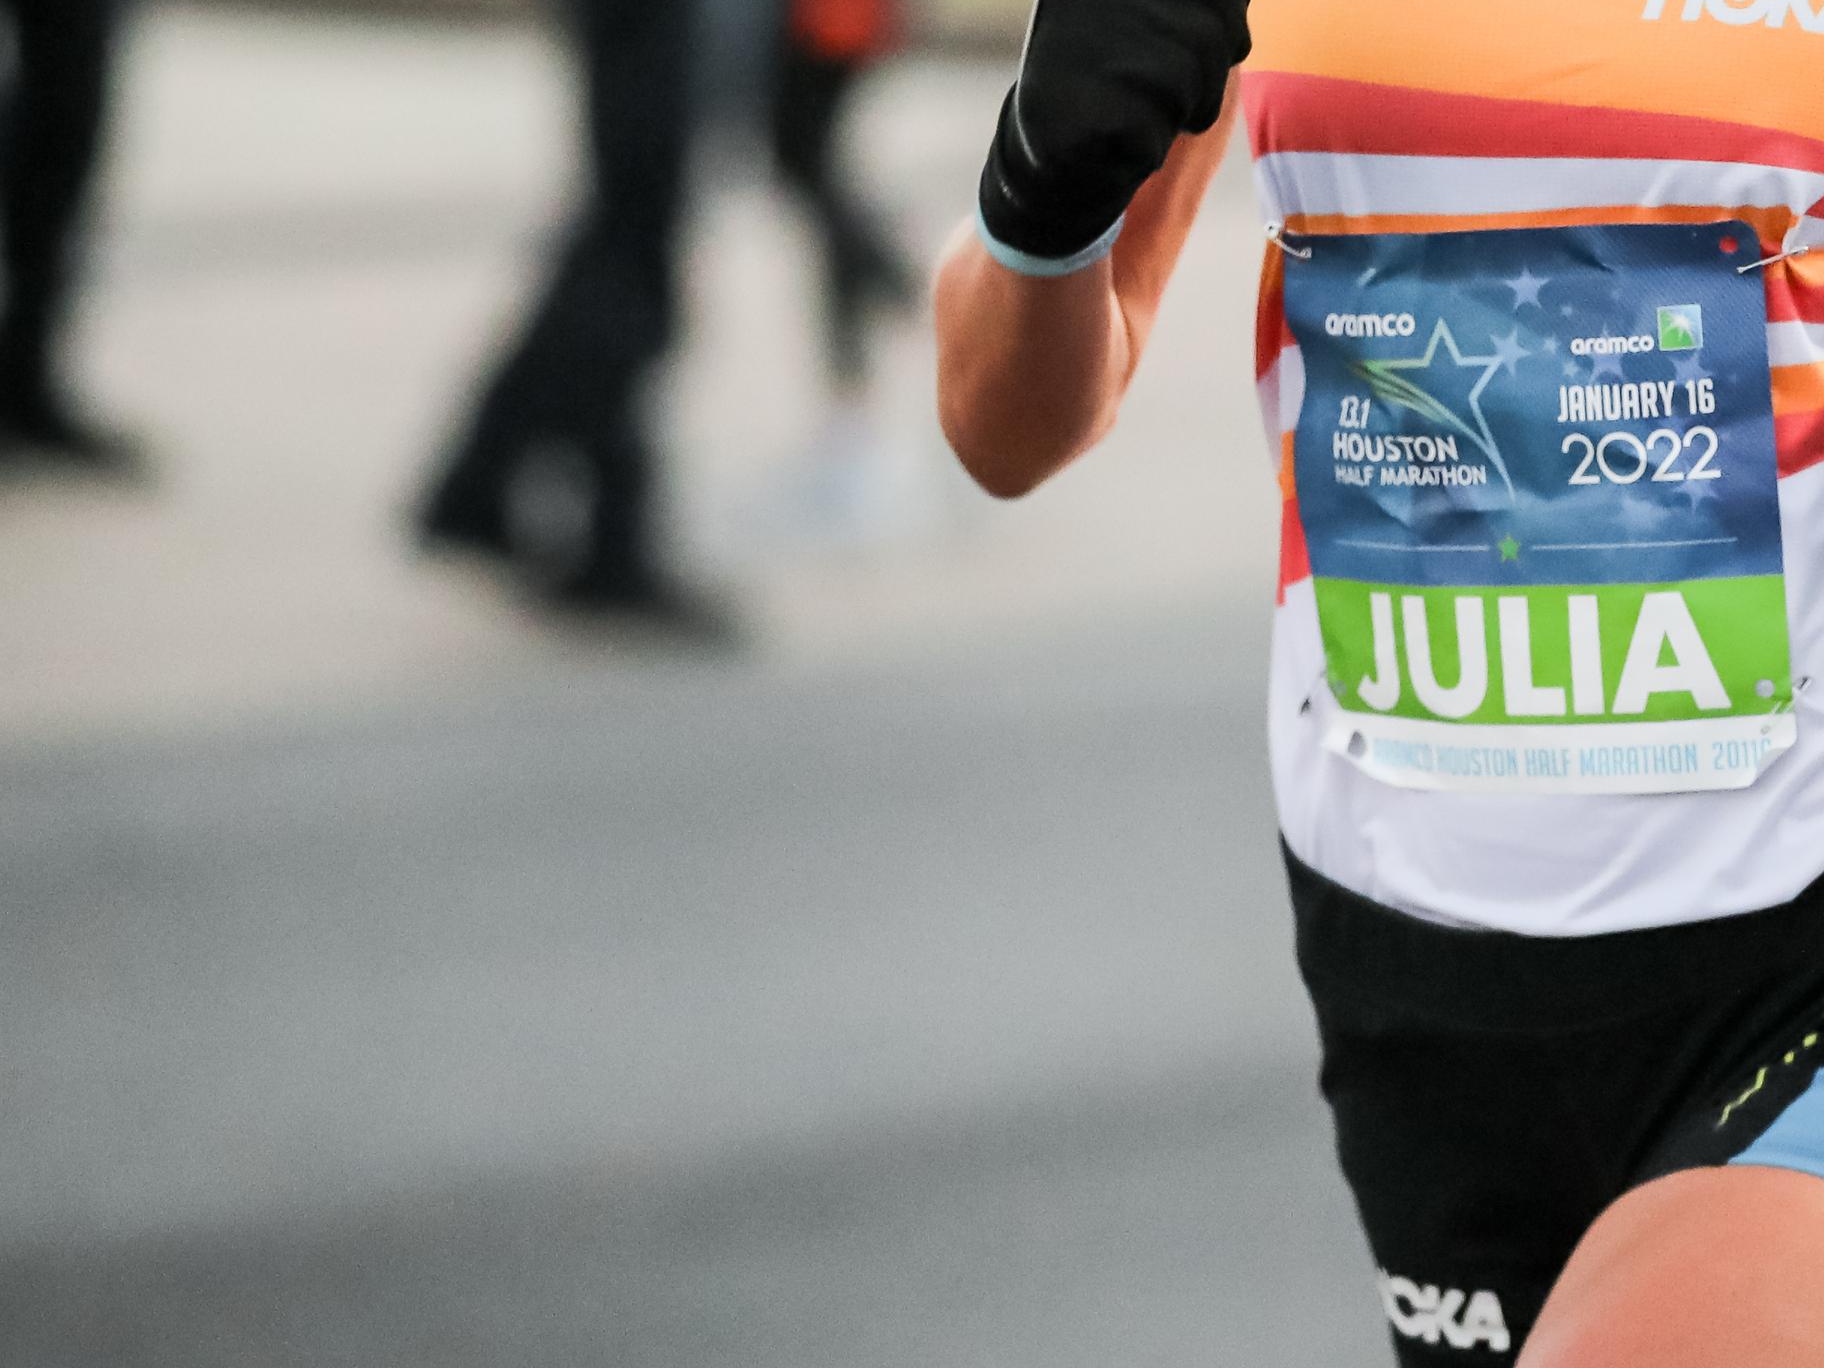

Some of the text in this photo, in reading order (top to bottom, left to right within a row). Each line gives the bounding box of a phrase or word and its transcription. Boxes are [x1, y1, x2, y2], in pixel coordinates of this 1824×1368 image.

[1324, 312, 1416, 337] aramco
[1569, 334, 1655, 355] aramco
[1557, 378, 1715, 423] JANUARY 16
[1332, 430, 1459, 463] HOUSTON
[1561, 425, 1722, 485] 2022
[1379, 463, 1487, 487] MARATHON
[1357, 590, 1732, 720] JULIA
[1524, 746, 1573, 778] HALF
[1578, 742, 1699, 777] MARATHON
[1380, 1274, 1512, 1353] OKA
